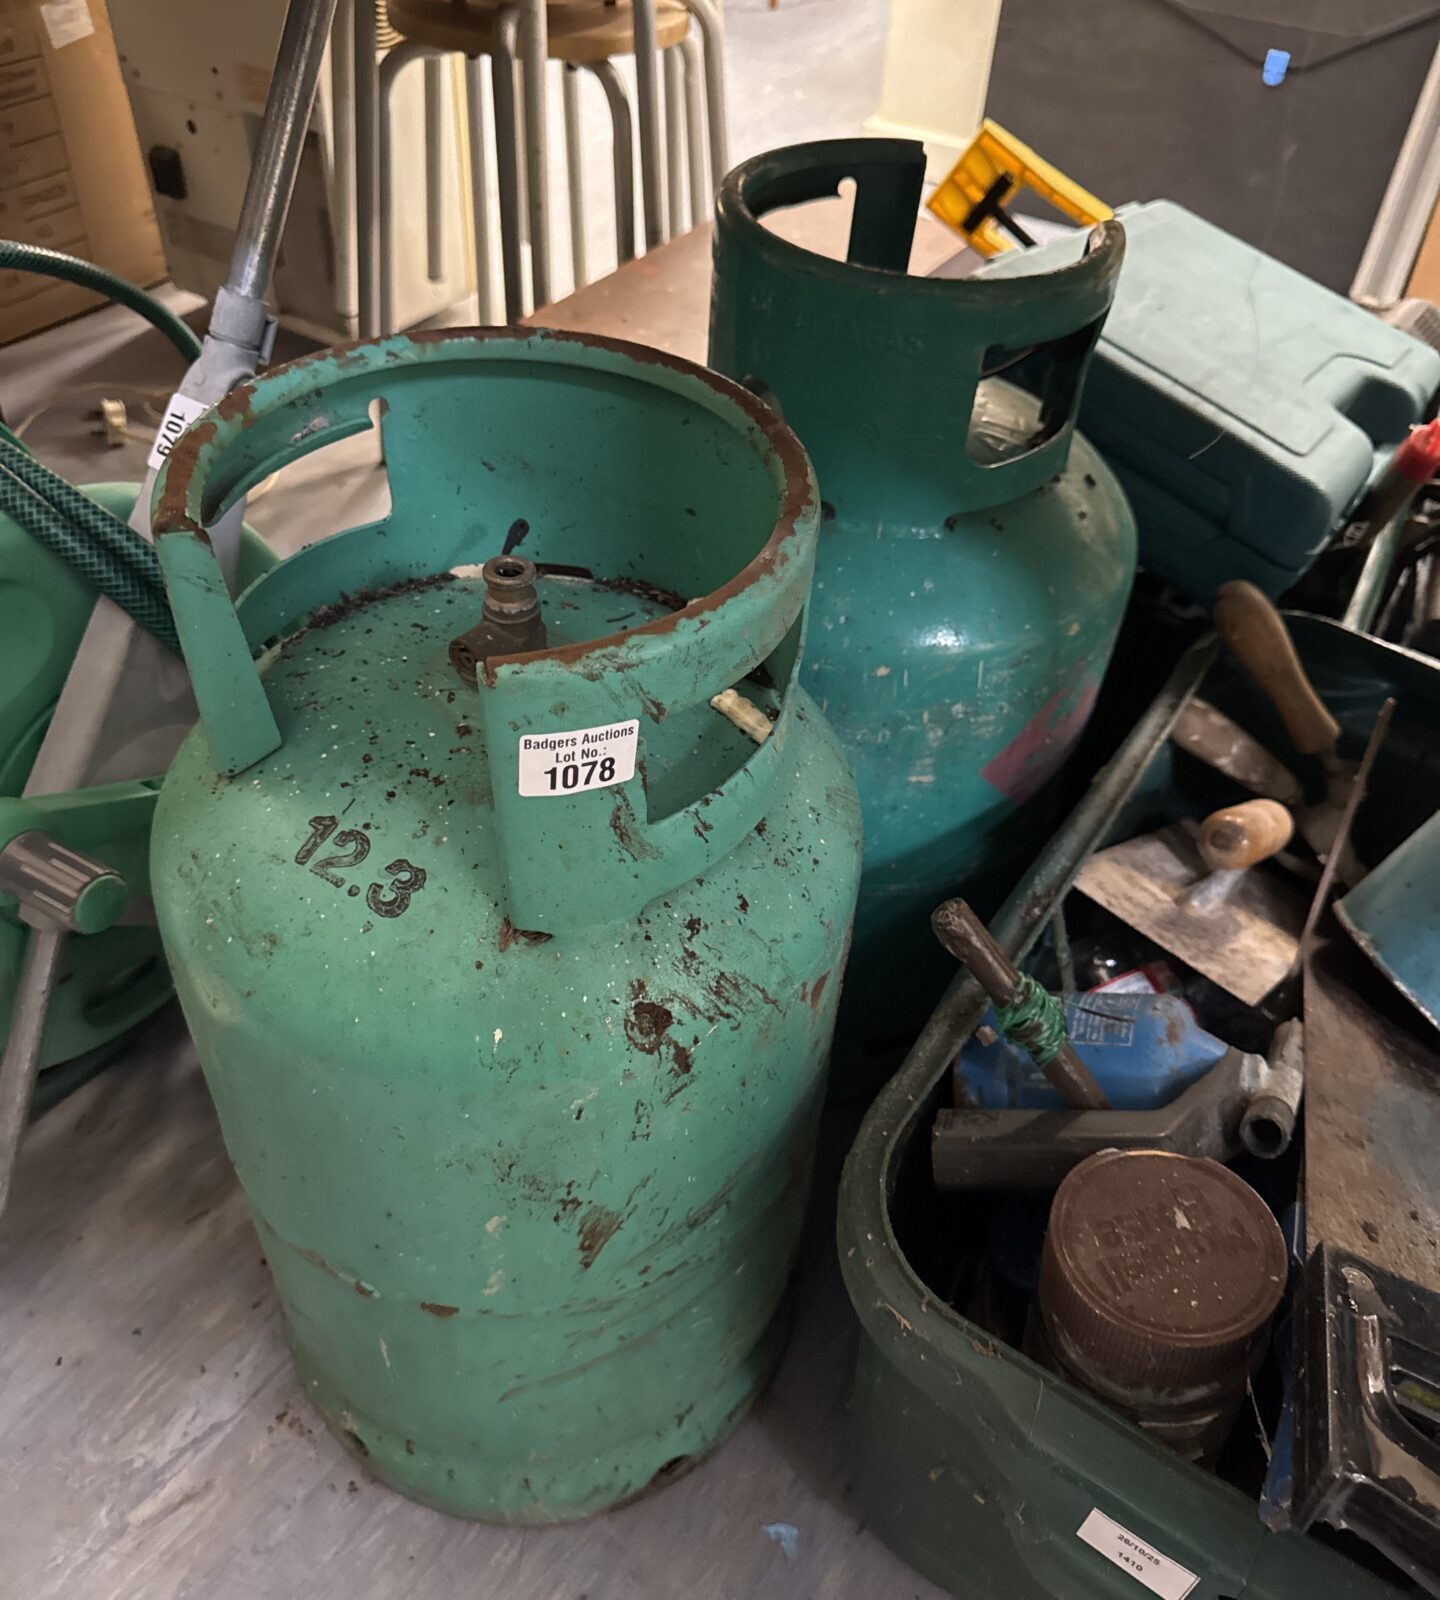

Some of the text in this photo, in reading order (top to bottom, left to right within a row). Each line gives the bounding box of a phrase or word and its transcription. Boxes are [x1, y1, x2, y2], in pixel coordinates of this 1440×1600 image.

[156, 411, 186, 457] 1079
[524, 726, 635, 751] Badgers Auctions
[544, 757, 616, 790] 1078
[555, 751, 576, 763] Lot
[295, 815, 427, 918] 12.3
[1117, 1533, 1160, 1566] 26/10/25
[1118, 1551, 1144, 1572] 1410
